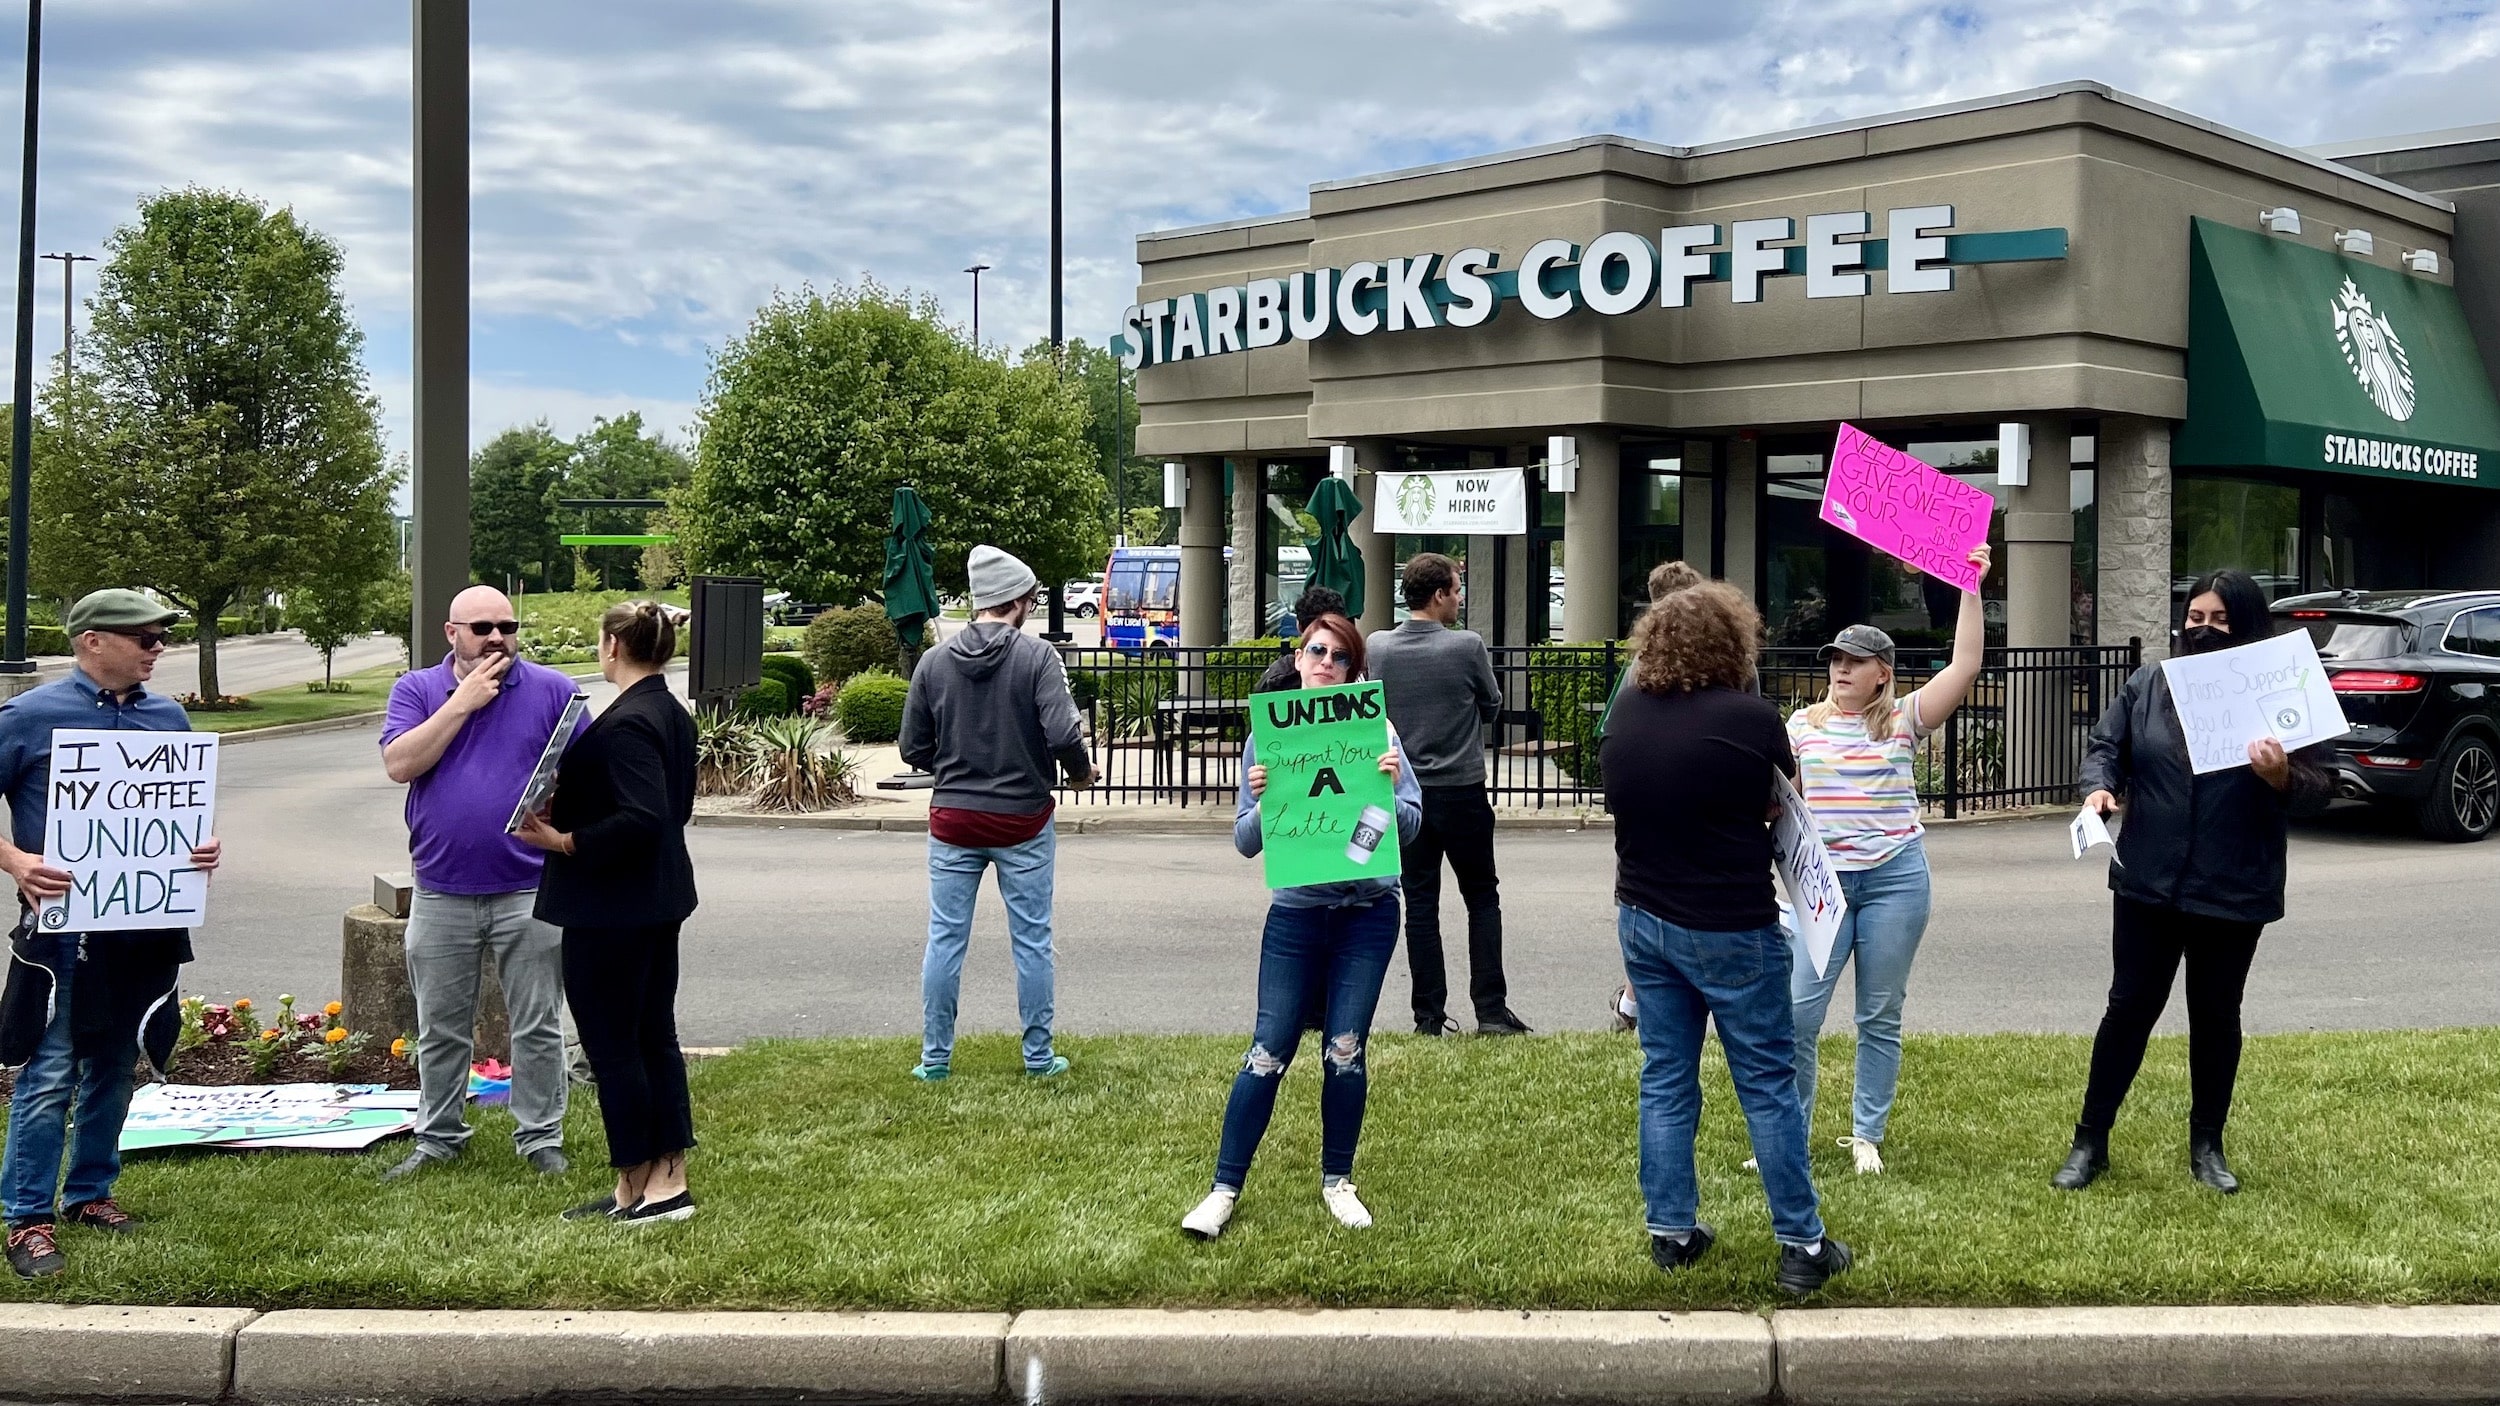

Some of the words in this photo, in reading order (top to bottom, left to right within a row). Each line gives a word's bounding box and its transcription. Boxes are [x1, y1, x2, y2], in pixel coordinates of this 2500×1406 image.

[1122, 247, 1499, 370] STARBUCKS
[1518, 204, 1955, 320] COFFEE
[1840, 430, 1906, 472] NEED
[2324, 434, 2422, 473] STARBUCKS
[2423, 448, 2478, 479] COFFEE
[1448, 499, 1497, 513] HIRING
[1456, 479, 1490, 493] NOW
[1839, 475, 1903, 532] YOUR
[1840, 452, 1903, 501] GIVE
[1903, 483, 1945, 522] ONE
[1947, 504, 1973, 534] TO
[1900, 533, 1978, 590] BARISTA
[2168, 666, 2224, 705] Unions
[2228, 655, 2301, 695] Support
[1267, 688, 1381, 729] UNIONS
[58, 742, 101, 774] I
[116, 741, 213, 773] WANT
[1262, 741, 1339, 774] Support
[1335, 740, 1377, 766] You
[2197, 735, 2245, 768] Latte
[54, 780, 100, 810] MY
[107, 779, 206, 810] COFFEE
[1308, 767, 1346, 798] A
[57, 814, 202, 862] UNION
[1265, 803, 1345, 840] Latte
[64, 867, 200, 919] MADE
[1812, 843, 1839, 922] UNION
